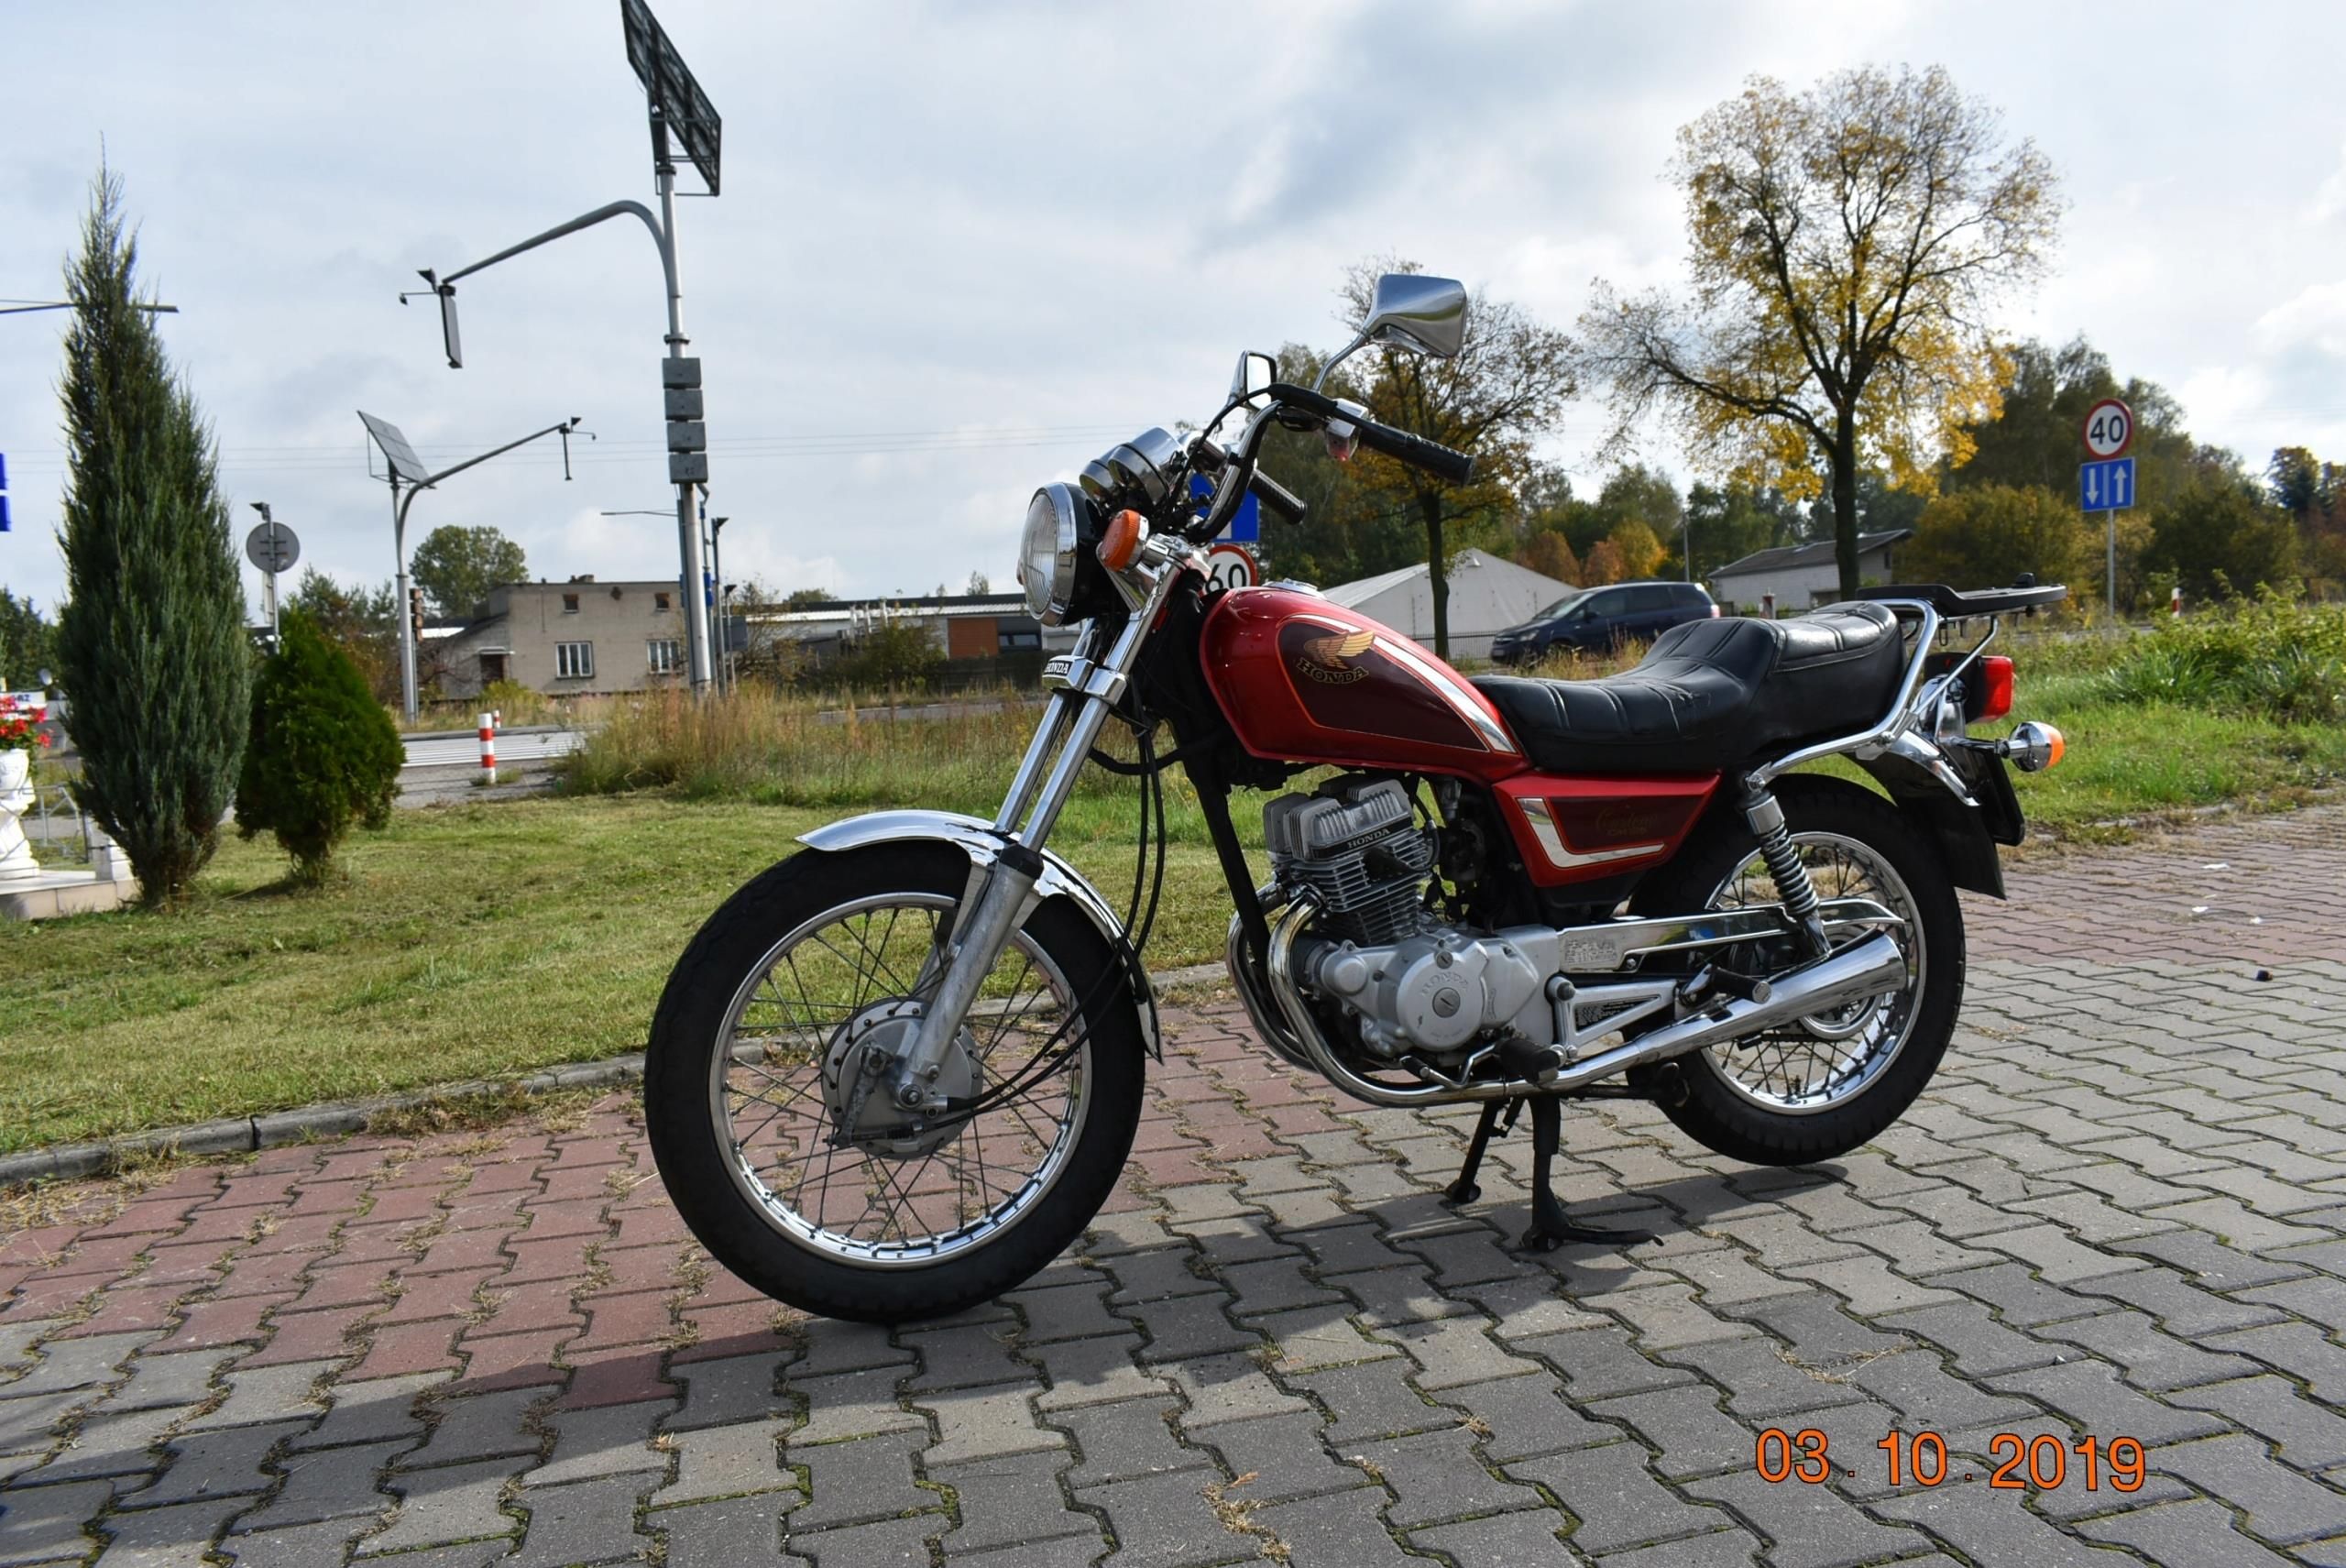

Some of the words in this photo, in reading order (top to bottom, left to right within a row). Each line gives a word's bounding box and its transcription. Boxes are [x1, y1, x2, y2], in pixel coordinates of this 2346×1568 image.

[2090, 415, 2124, 445] 40
[1205, 563, 1247, 593] 60
[1296, 657, 1369, 684] HONDA
[1347, 828, 1390, 849] HONDA
